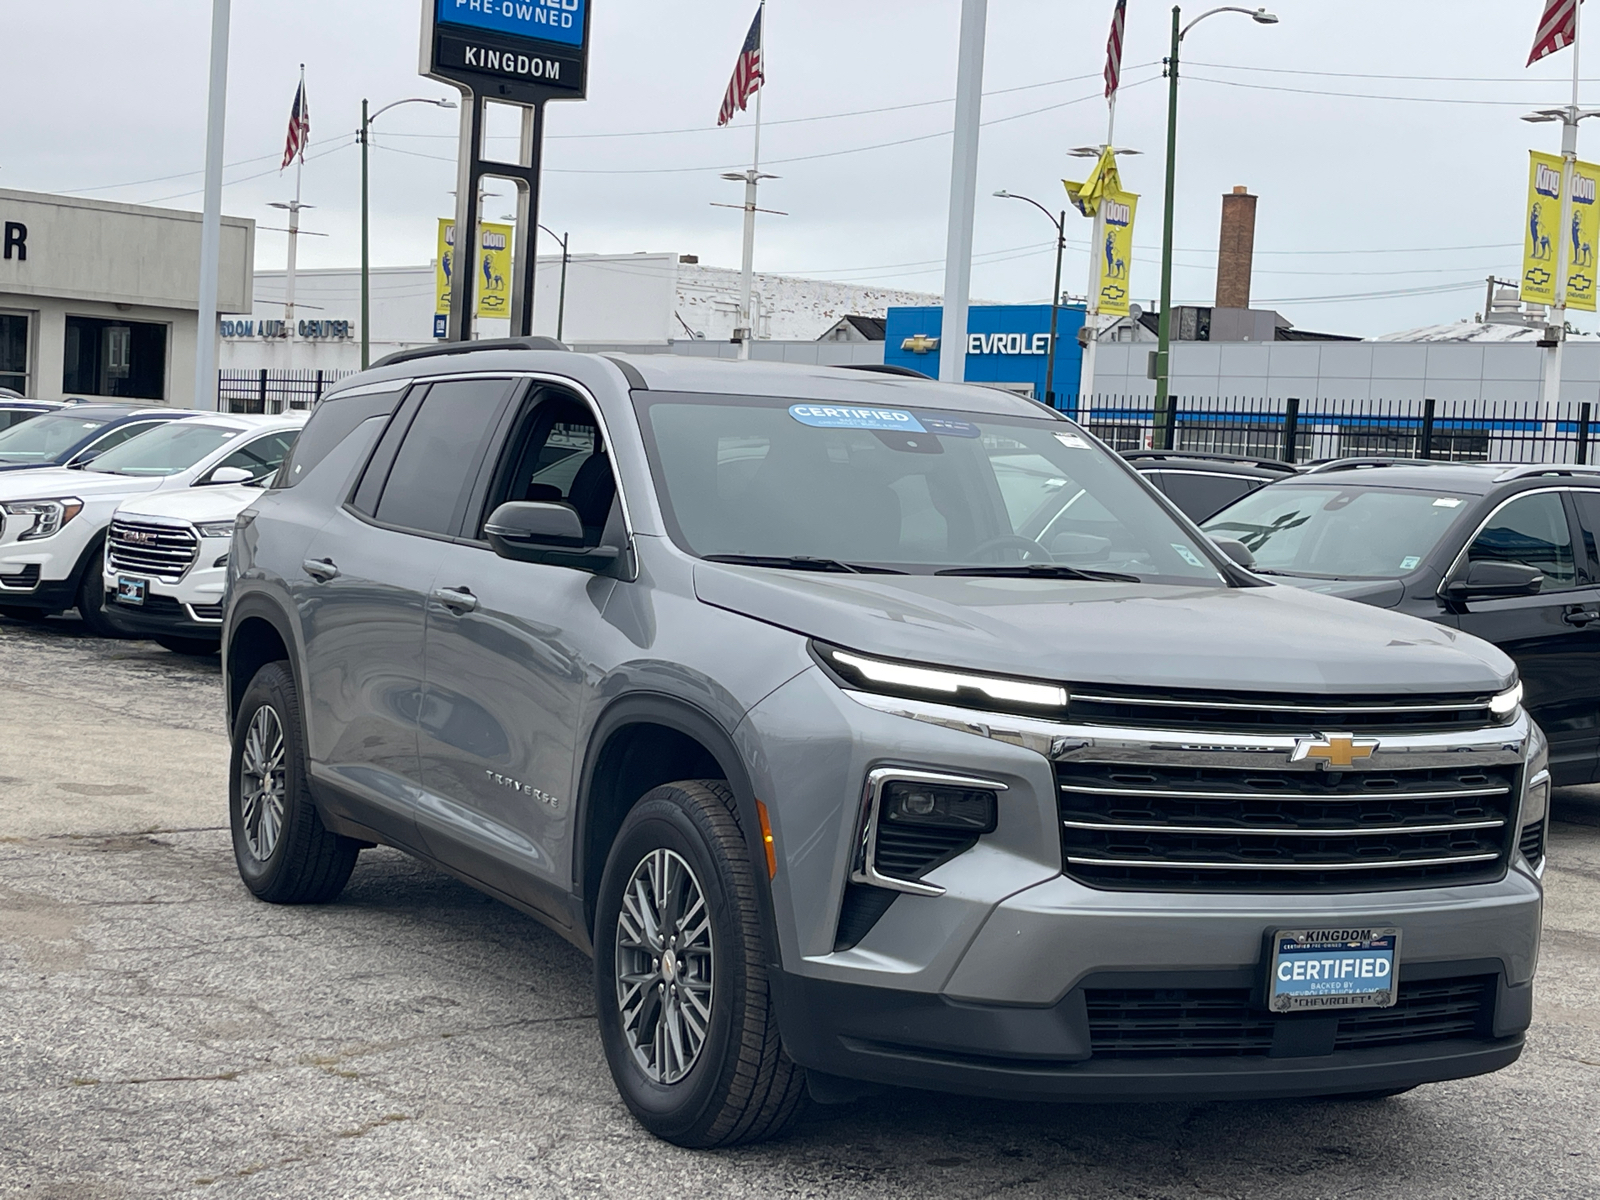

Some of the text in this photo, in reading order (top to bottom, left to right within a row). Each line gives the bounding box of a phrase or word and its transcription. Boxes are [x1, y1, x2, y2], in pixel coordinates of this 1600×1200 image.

[456, 0, 573, 29] PRE-OWNED
[465, 46, 560, 80] KINGDOM
[1535, 163, 1595, 202] King dom
[1106, 199, 1130, 225] dom
[4, 221, 28, 261] R
[482, 230, 506, 249] dom
[258, 320, 287, 338] AUT
[298, 319, 351, 339] CENTER
[966, 333, 1059, 355] EVROLET
[794, 406, 910, 422] CERTIFIED
[123, 531, 157, 546] GMC
[486, 770, 559, 808] TRAVERSE
[1305, 930, 1371, 941] KINGDOM
[1277, 958, 1390, 981] CERTIFIED
[1311, 982, 1342, 990] BACKED
[1299, 996, 1366, 1007] CHEVROLET
